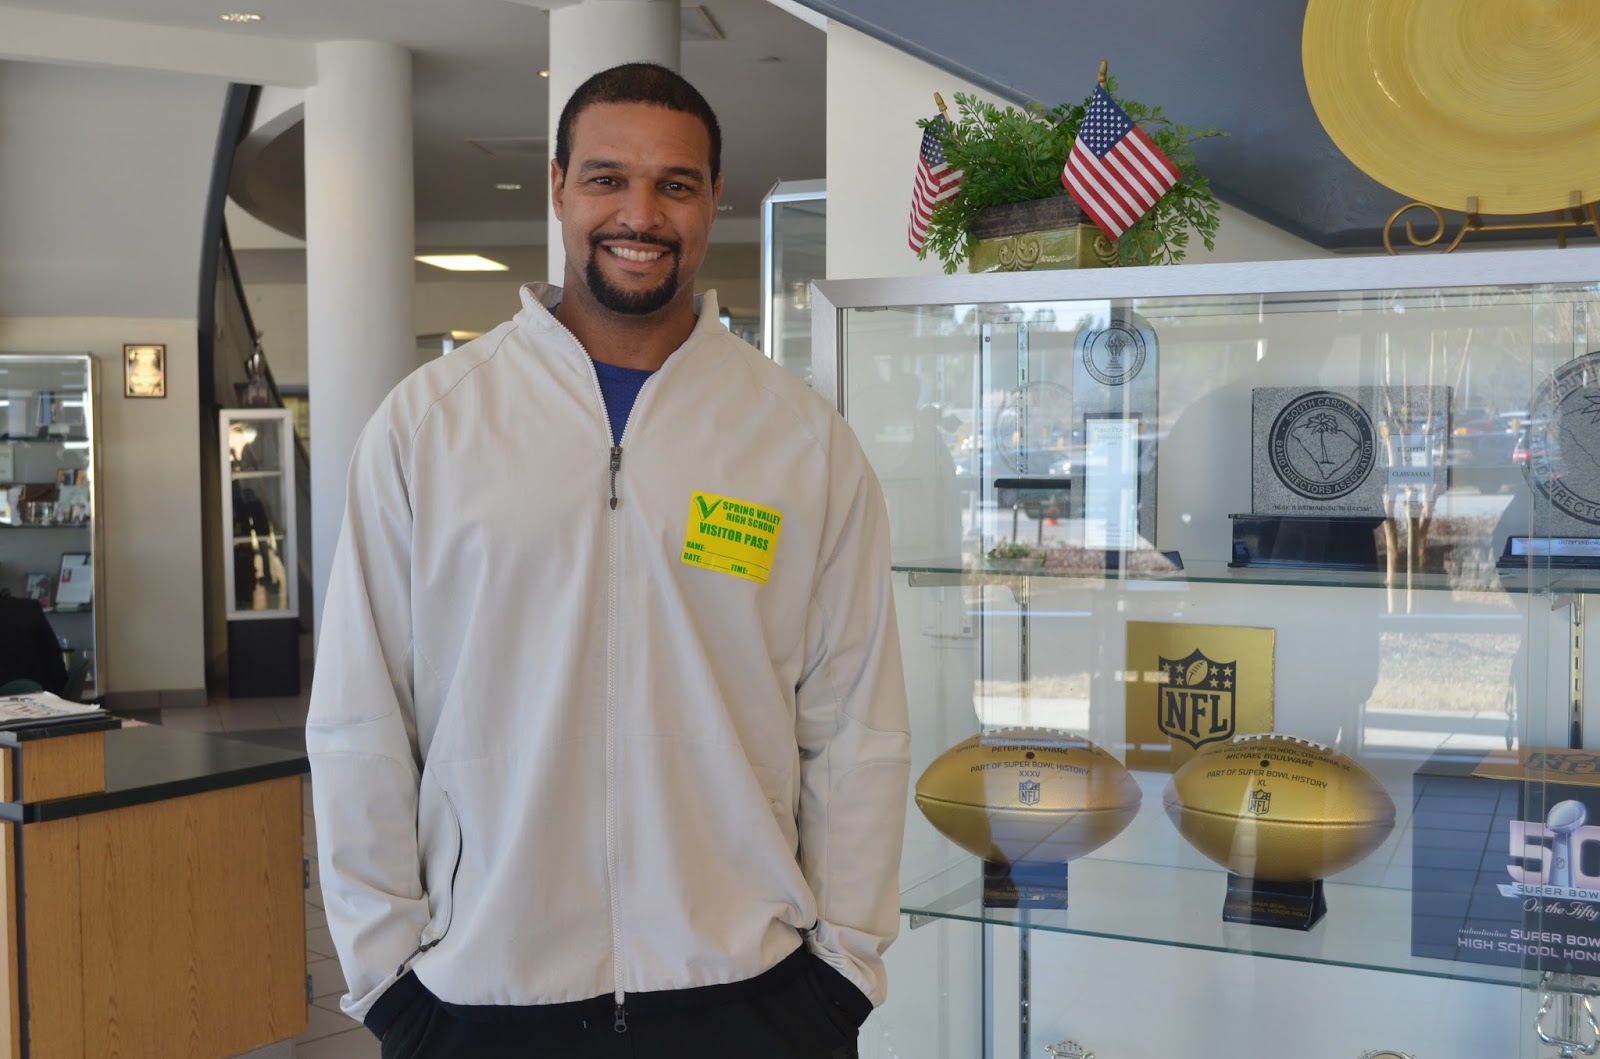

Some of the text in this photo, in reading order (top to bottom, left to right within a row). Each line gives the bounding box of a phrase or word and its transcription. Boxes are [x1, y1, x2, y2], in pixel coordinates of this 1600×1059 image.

[1286, 398, 1361, 422] SOUTH CAROLINA
[1275, 440, 1372, 494] BAND DIRECTORS ASSOCIATION
[722, 501, 781, 525] SPRING VALLEY
[726, 512, 775, 534] HIGH SCHOOL
[700, 522, 769, 551] VISITOR PASS
[686, 541, 706, 552] NAME:
[683, 552, 702, 563] DATE:
[730, 564, 748, 575] TIME:
[1165, 691, 1228, 738] NFL
[992, 744, 1068, 755] PETER BOULWARE
[971, 763, 990, 773] PART
[992, 761, 1002, 769] OF
[1032, 761, 1054, 769] BOWL
[1056, 763, 1089, 775] HISTORY
[1226, 752, 1314, 768] MICHAEL BOULWARE
[1207, 769, 1224, 779] PART
[1238, 769, 1264, 777] SUPER
[1266, 770, 1289, 780] BOWL
[1291, 775, 1327, 789] HISTORY
[1021, 790, 1038, 802] NFL
[1250, 799, 1267, 812] NFL
[1517, 884, 1562, 896] SUPER
[1523, 898, 1599, 921] On the Fifty
[1510, 929, 1562, 944] SUPER
[1457, 937, 1493, 950] HIGH
[1497, 941, 1560, 958] SCHOOL
